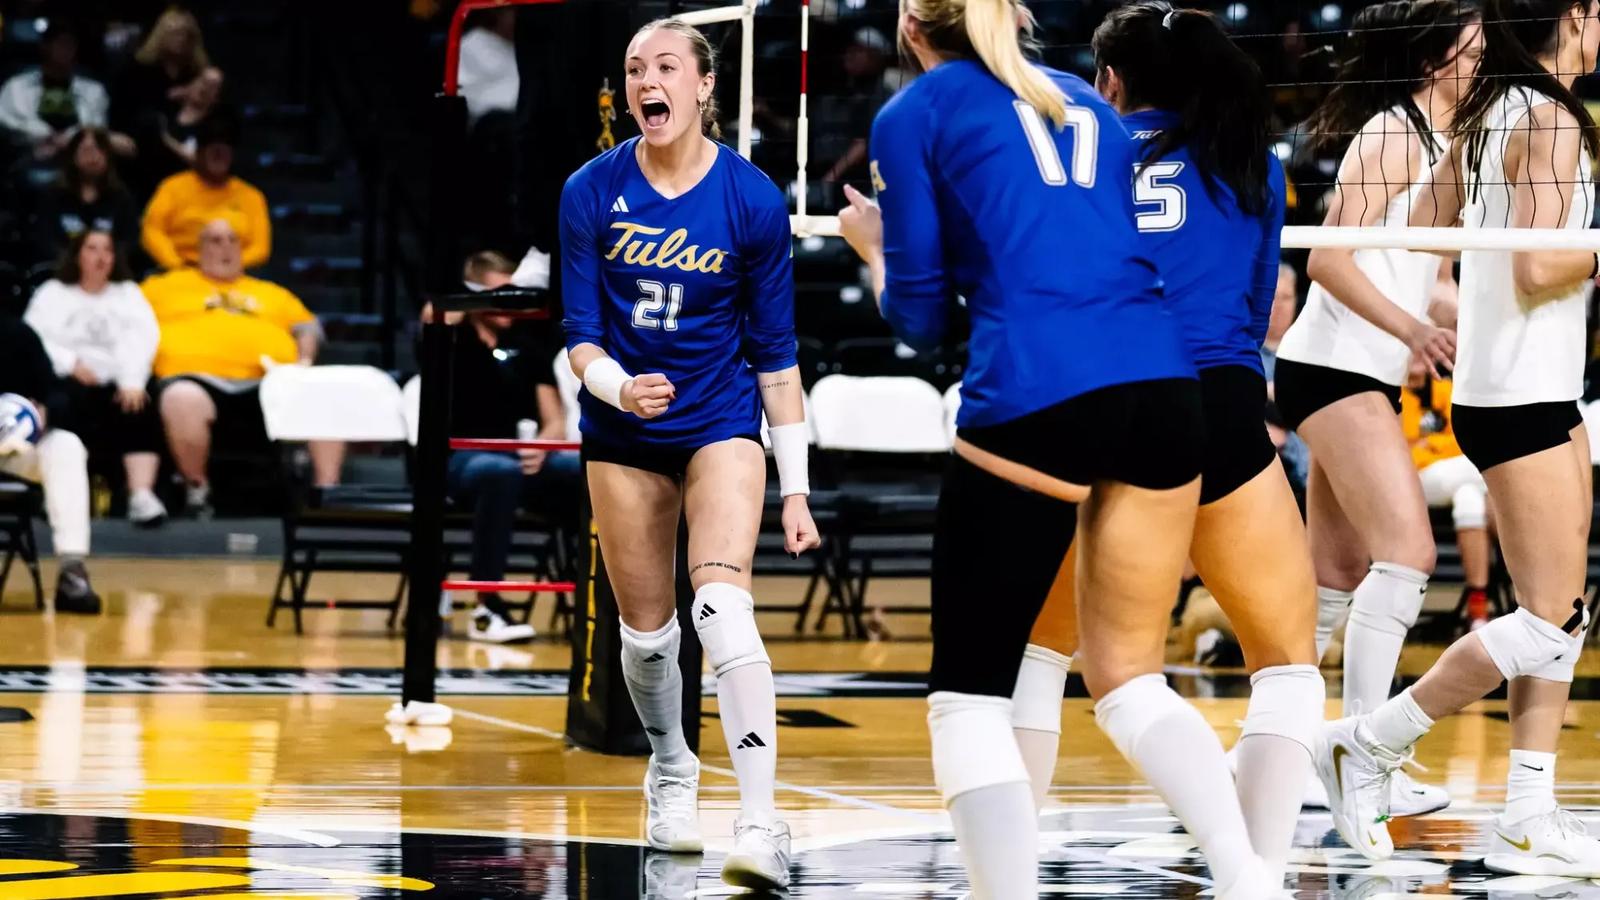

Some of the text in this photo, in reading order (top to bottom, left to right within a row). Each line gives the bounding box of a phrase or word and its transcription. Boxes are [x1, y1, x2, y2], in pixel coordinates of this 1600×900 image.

[1012, 99, 1099, 189] 17
[1131, 161, 1187, 233] 5
[604, 221, 729, 273] Tulsa
[631, 278, 684, 331] 21
